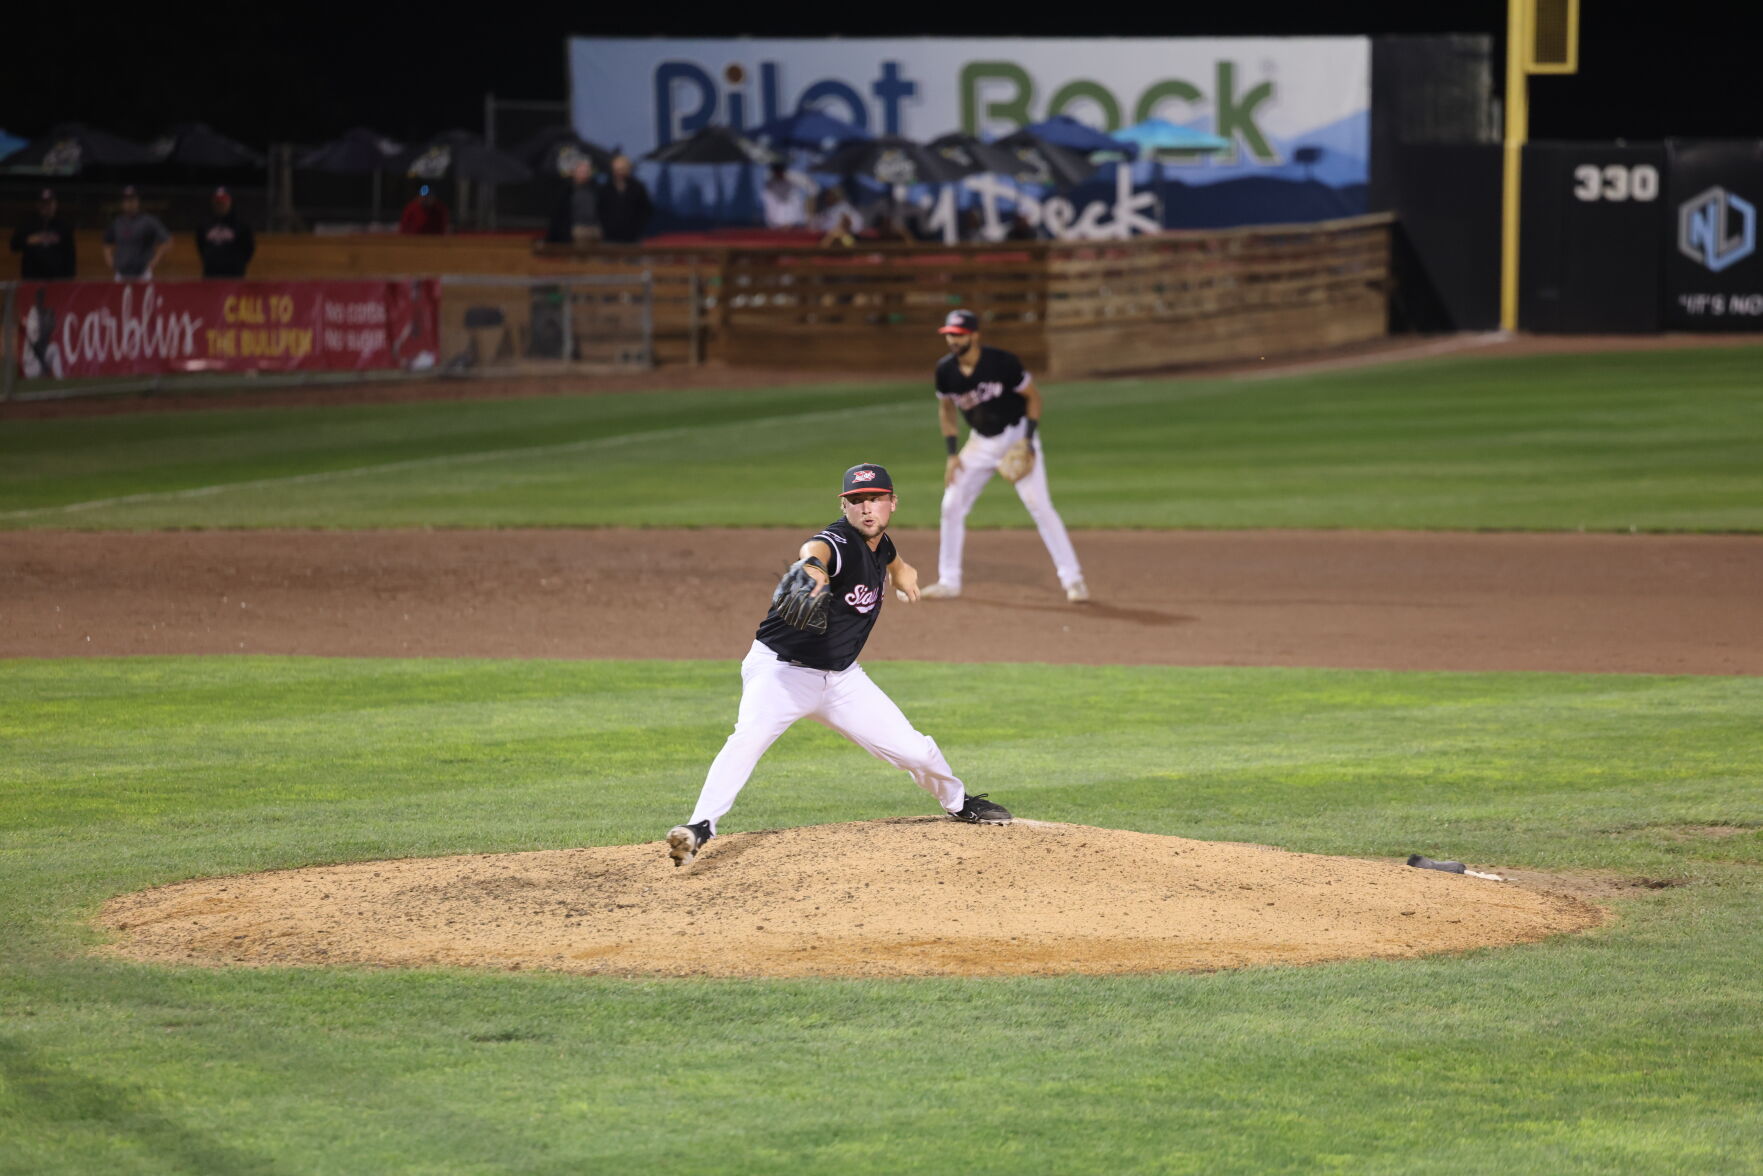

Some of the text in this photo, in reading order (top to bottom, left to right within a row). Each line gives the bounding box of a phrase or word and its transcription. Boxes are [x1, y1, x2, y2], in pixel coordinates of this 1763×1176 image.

[655, 60, 1273, 160] Pilot Rock
[1573, 164, 1659, 202] 330
[63, 285, 204, 366] carbliss
[223, 294, 294, 324] CALL TO
[206, 328, 313, 357] THE BULLPEN
